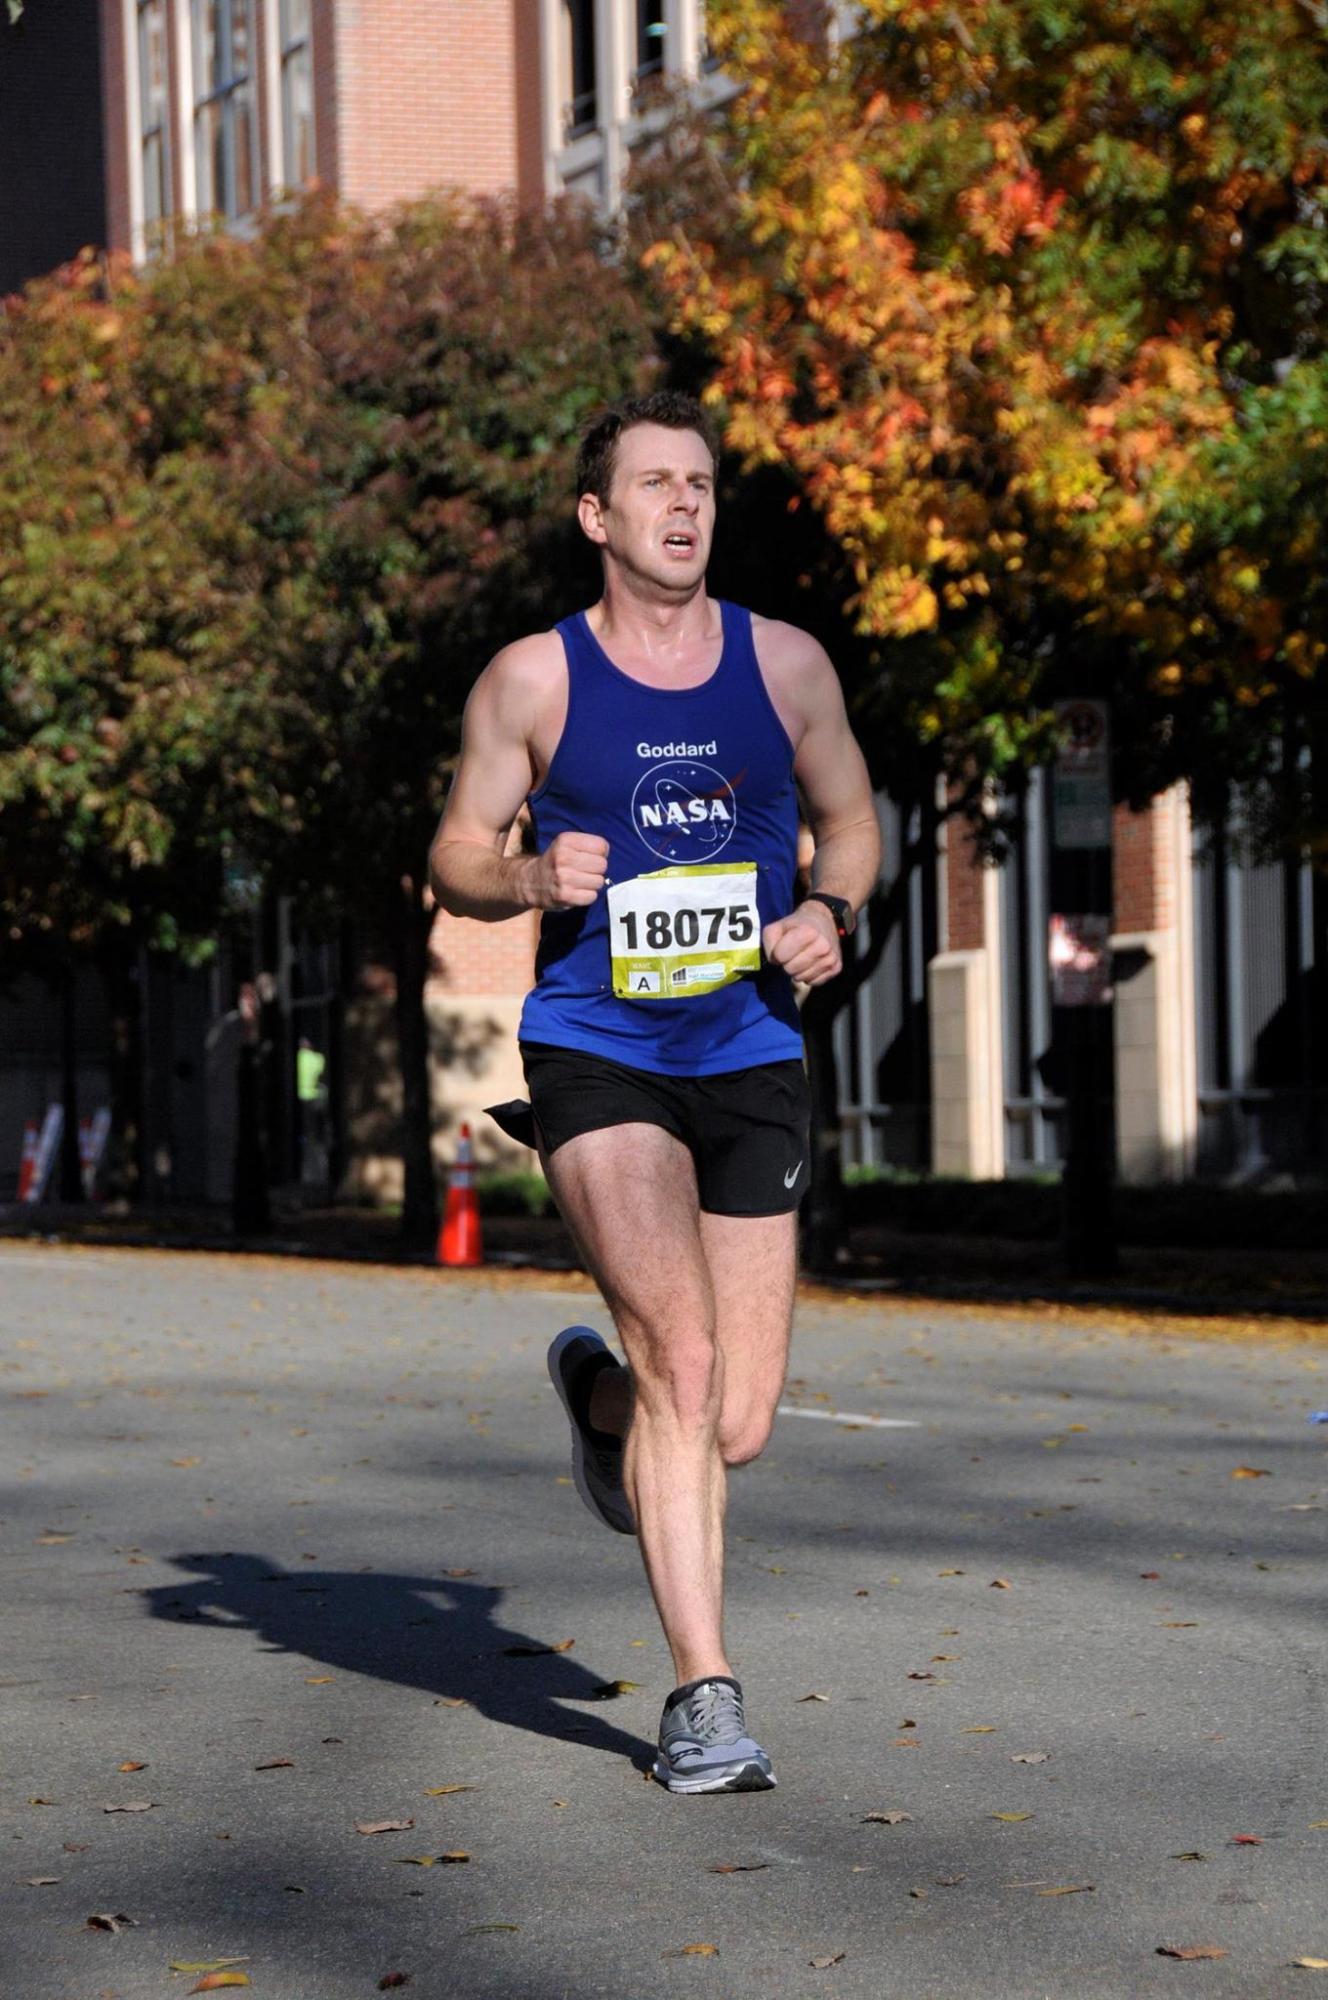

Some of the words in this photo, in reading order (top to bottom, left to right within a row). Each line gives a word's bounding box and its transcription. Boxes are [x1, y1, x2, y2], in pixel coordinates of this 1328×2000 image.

[637, 740, 717, 758] Goddard
[640, 799, 731, 827] NASA
[620, 904, 754, 949] 18075
[637, 976, 651, 991] A
